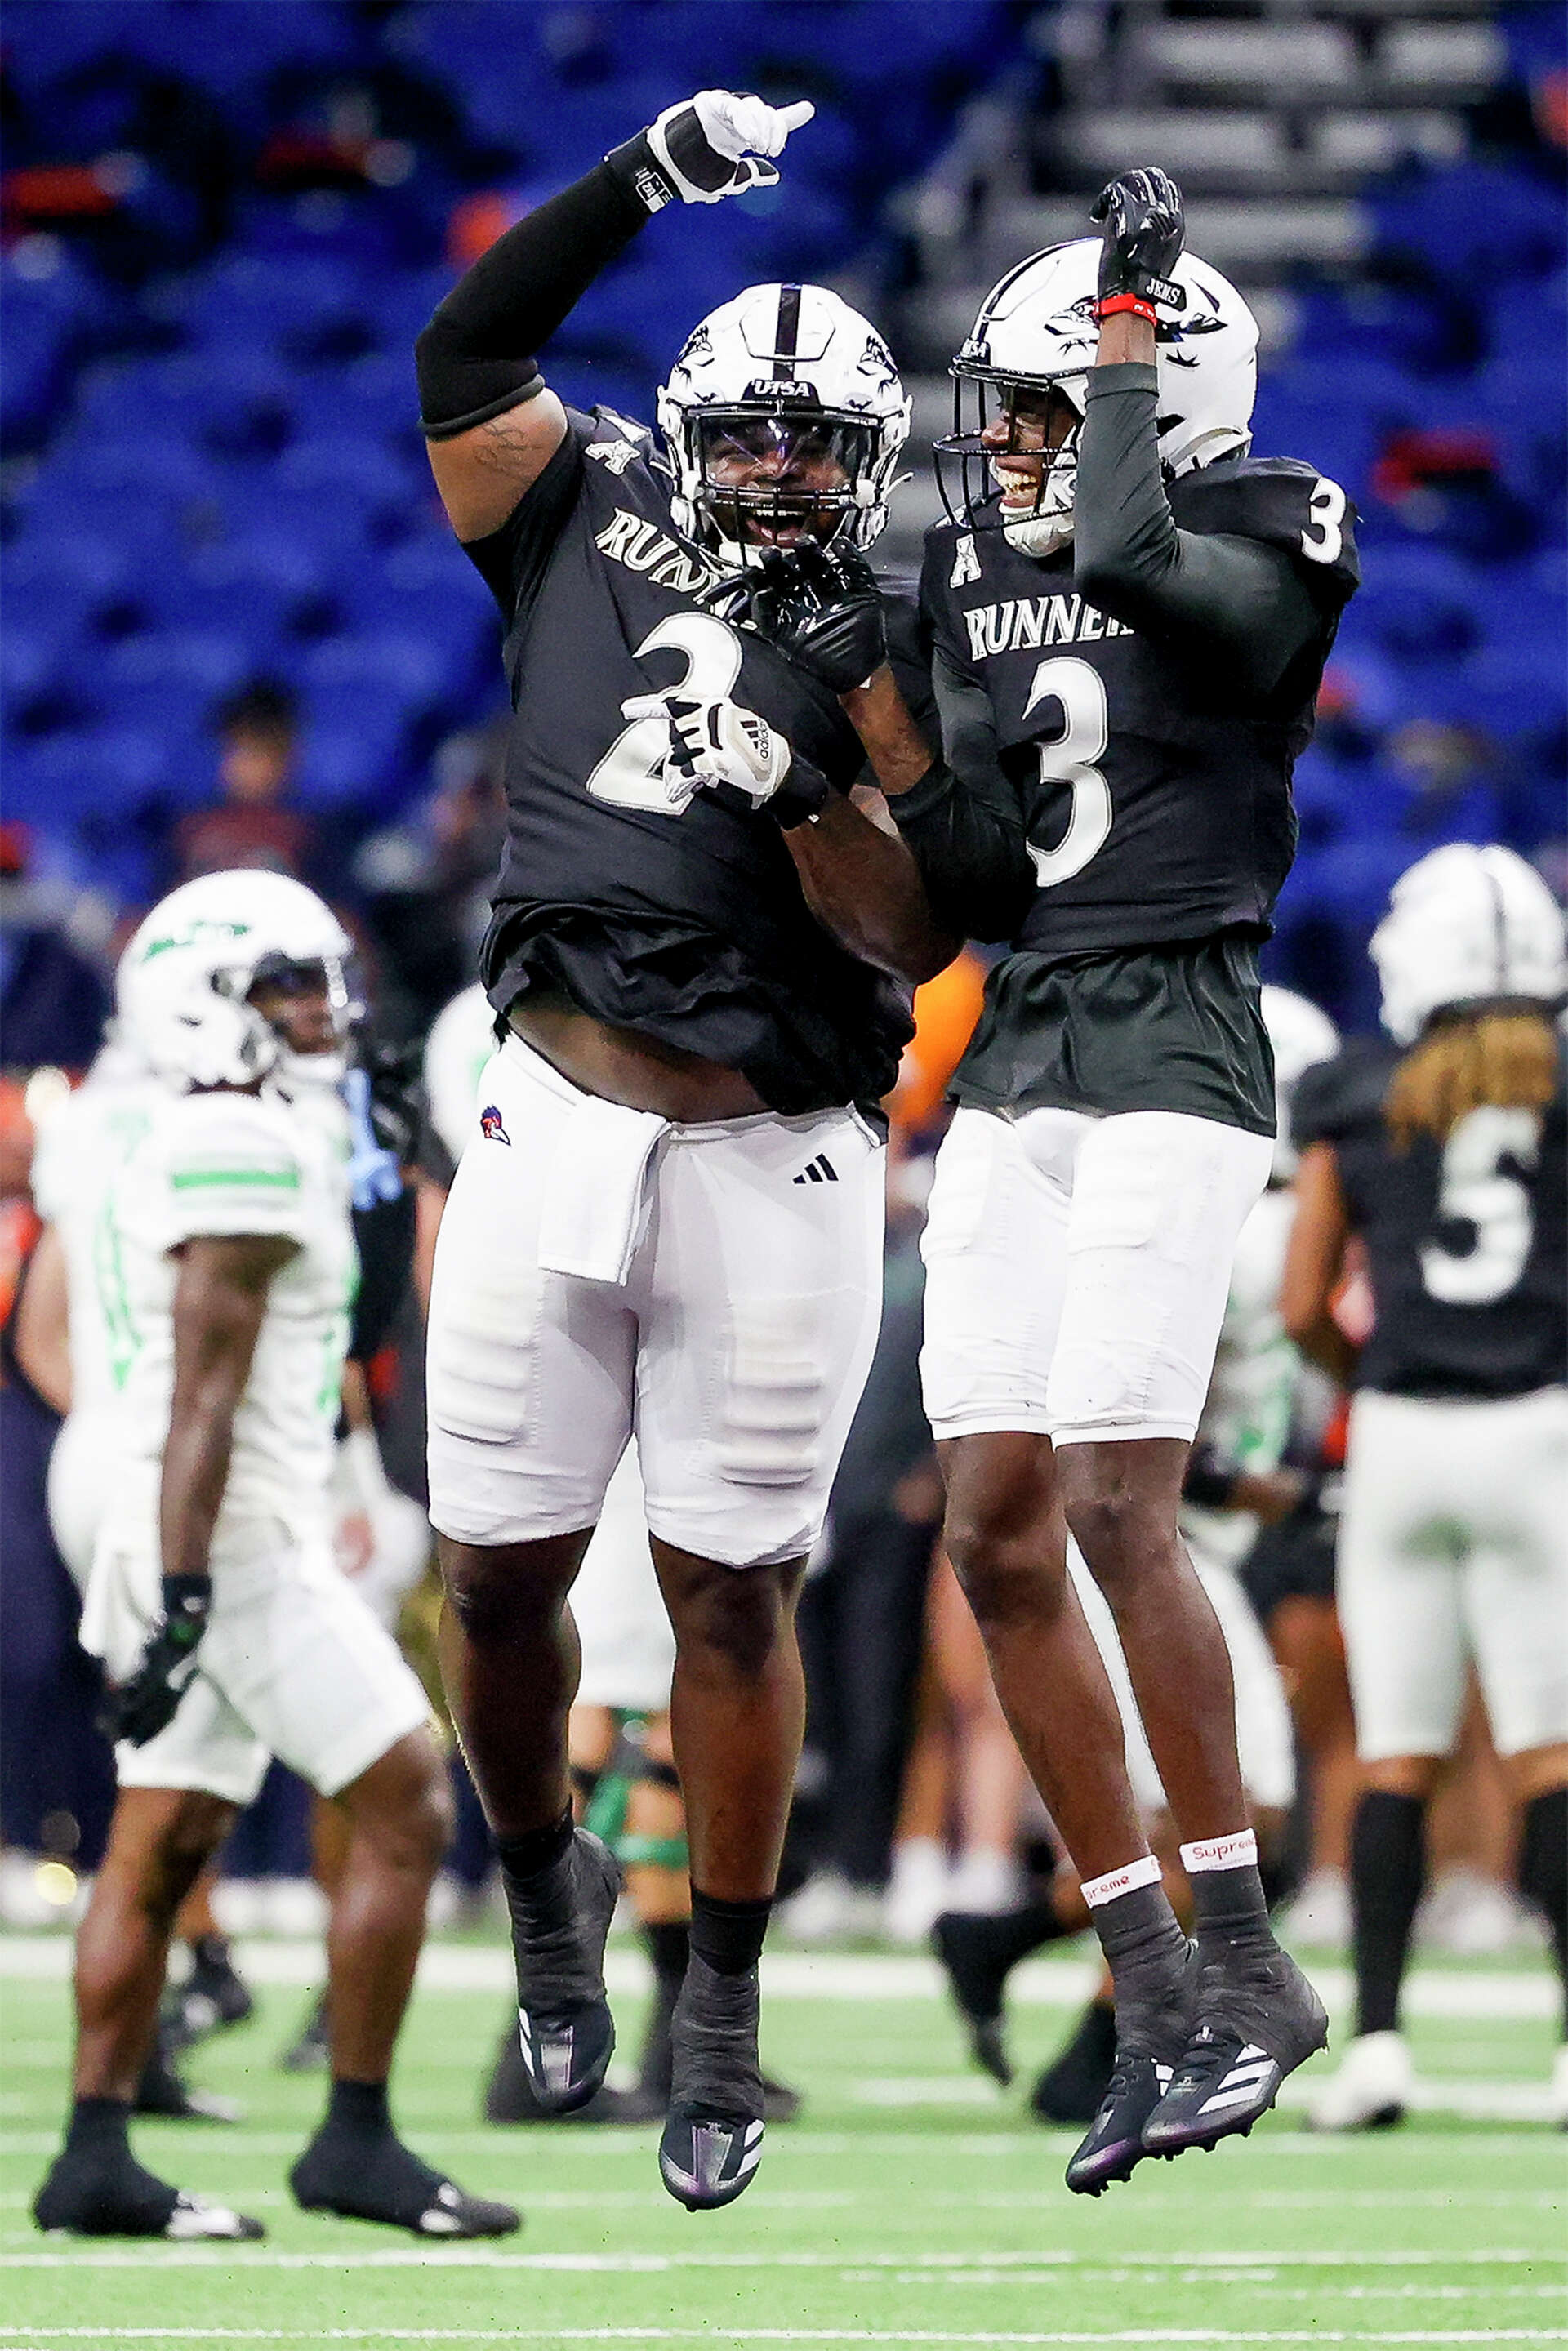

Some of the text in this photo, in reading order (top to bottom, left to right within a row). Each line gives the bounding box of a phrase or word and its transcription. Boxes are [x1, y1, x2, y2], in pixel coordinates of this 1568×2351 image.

[752, 380, 810, 398] UTSA
[949, 532, 982, 589] A
[1300, 476, 1347, 564] 3
[586, 610, 743, 816] 2
[1022, 656, 1113, 888] 3
[1417, 1102, 1540, 1307] 5
